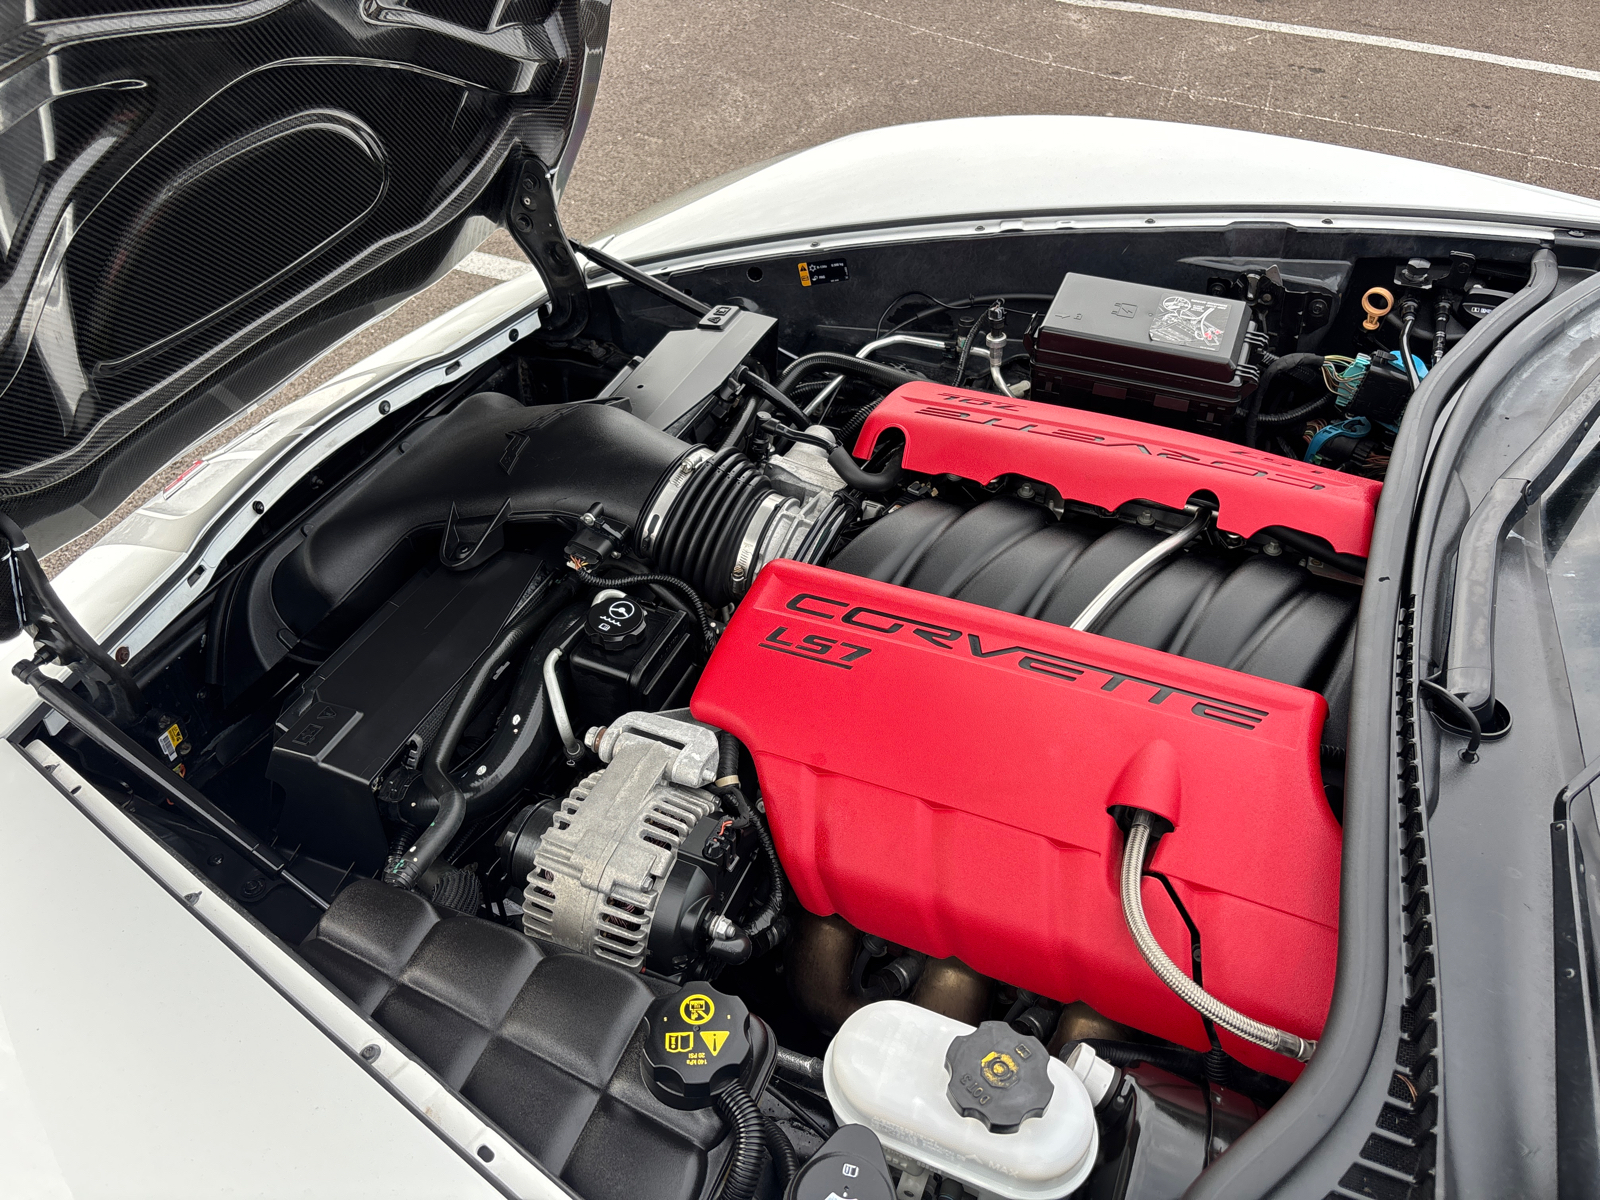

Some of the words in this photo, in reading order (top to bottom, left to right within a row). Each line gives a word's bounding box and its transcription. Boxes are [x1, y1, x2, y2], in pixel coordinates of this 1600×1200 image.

[914, 406, 1326, 491] CORVETTE
[764, 626, 872, 663] LS7
[785, 593, 1270, 731] CORVETTE
[960, 1073, 972, 1086] 3
[965, 1081, 991, 1105] DOT
[988, 1160, 1020, 1178] MAX
